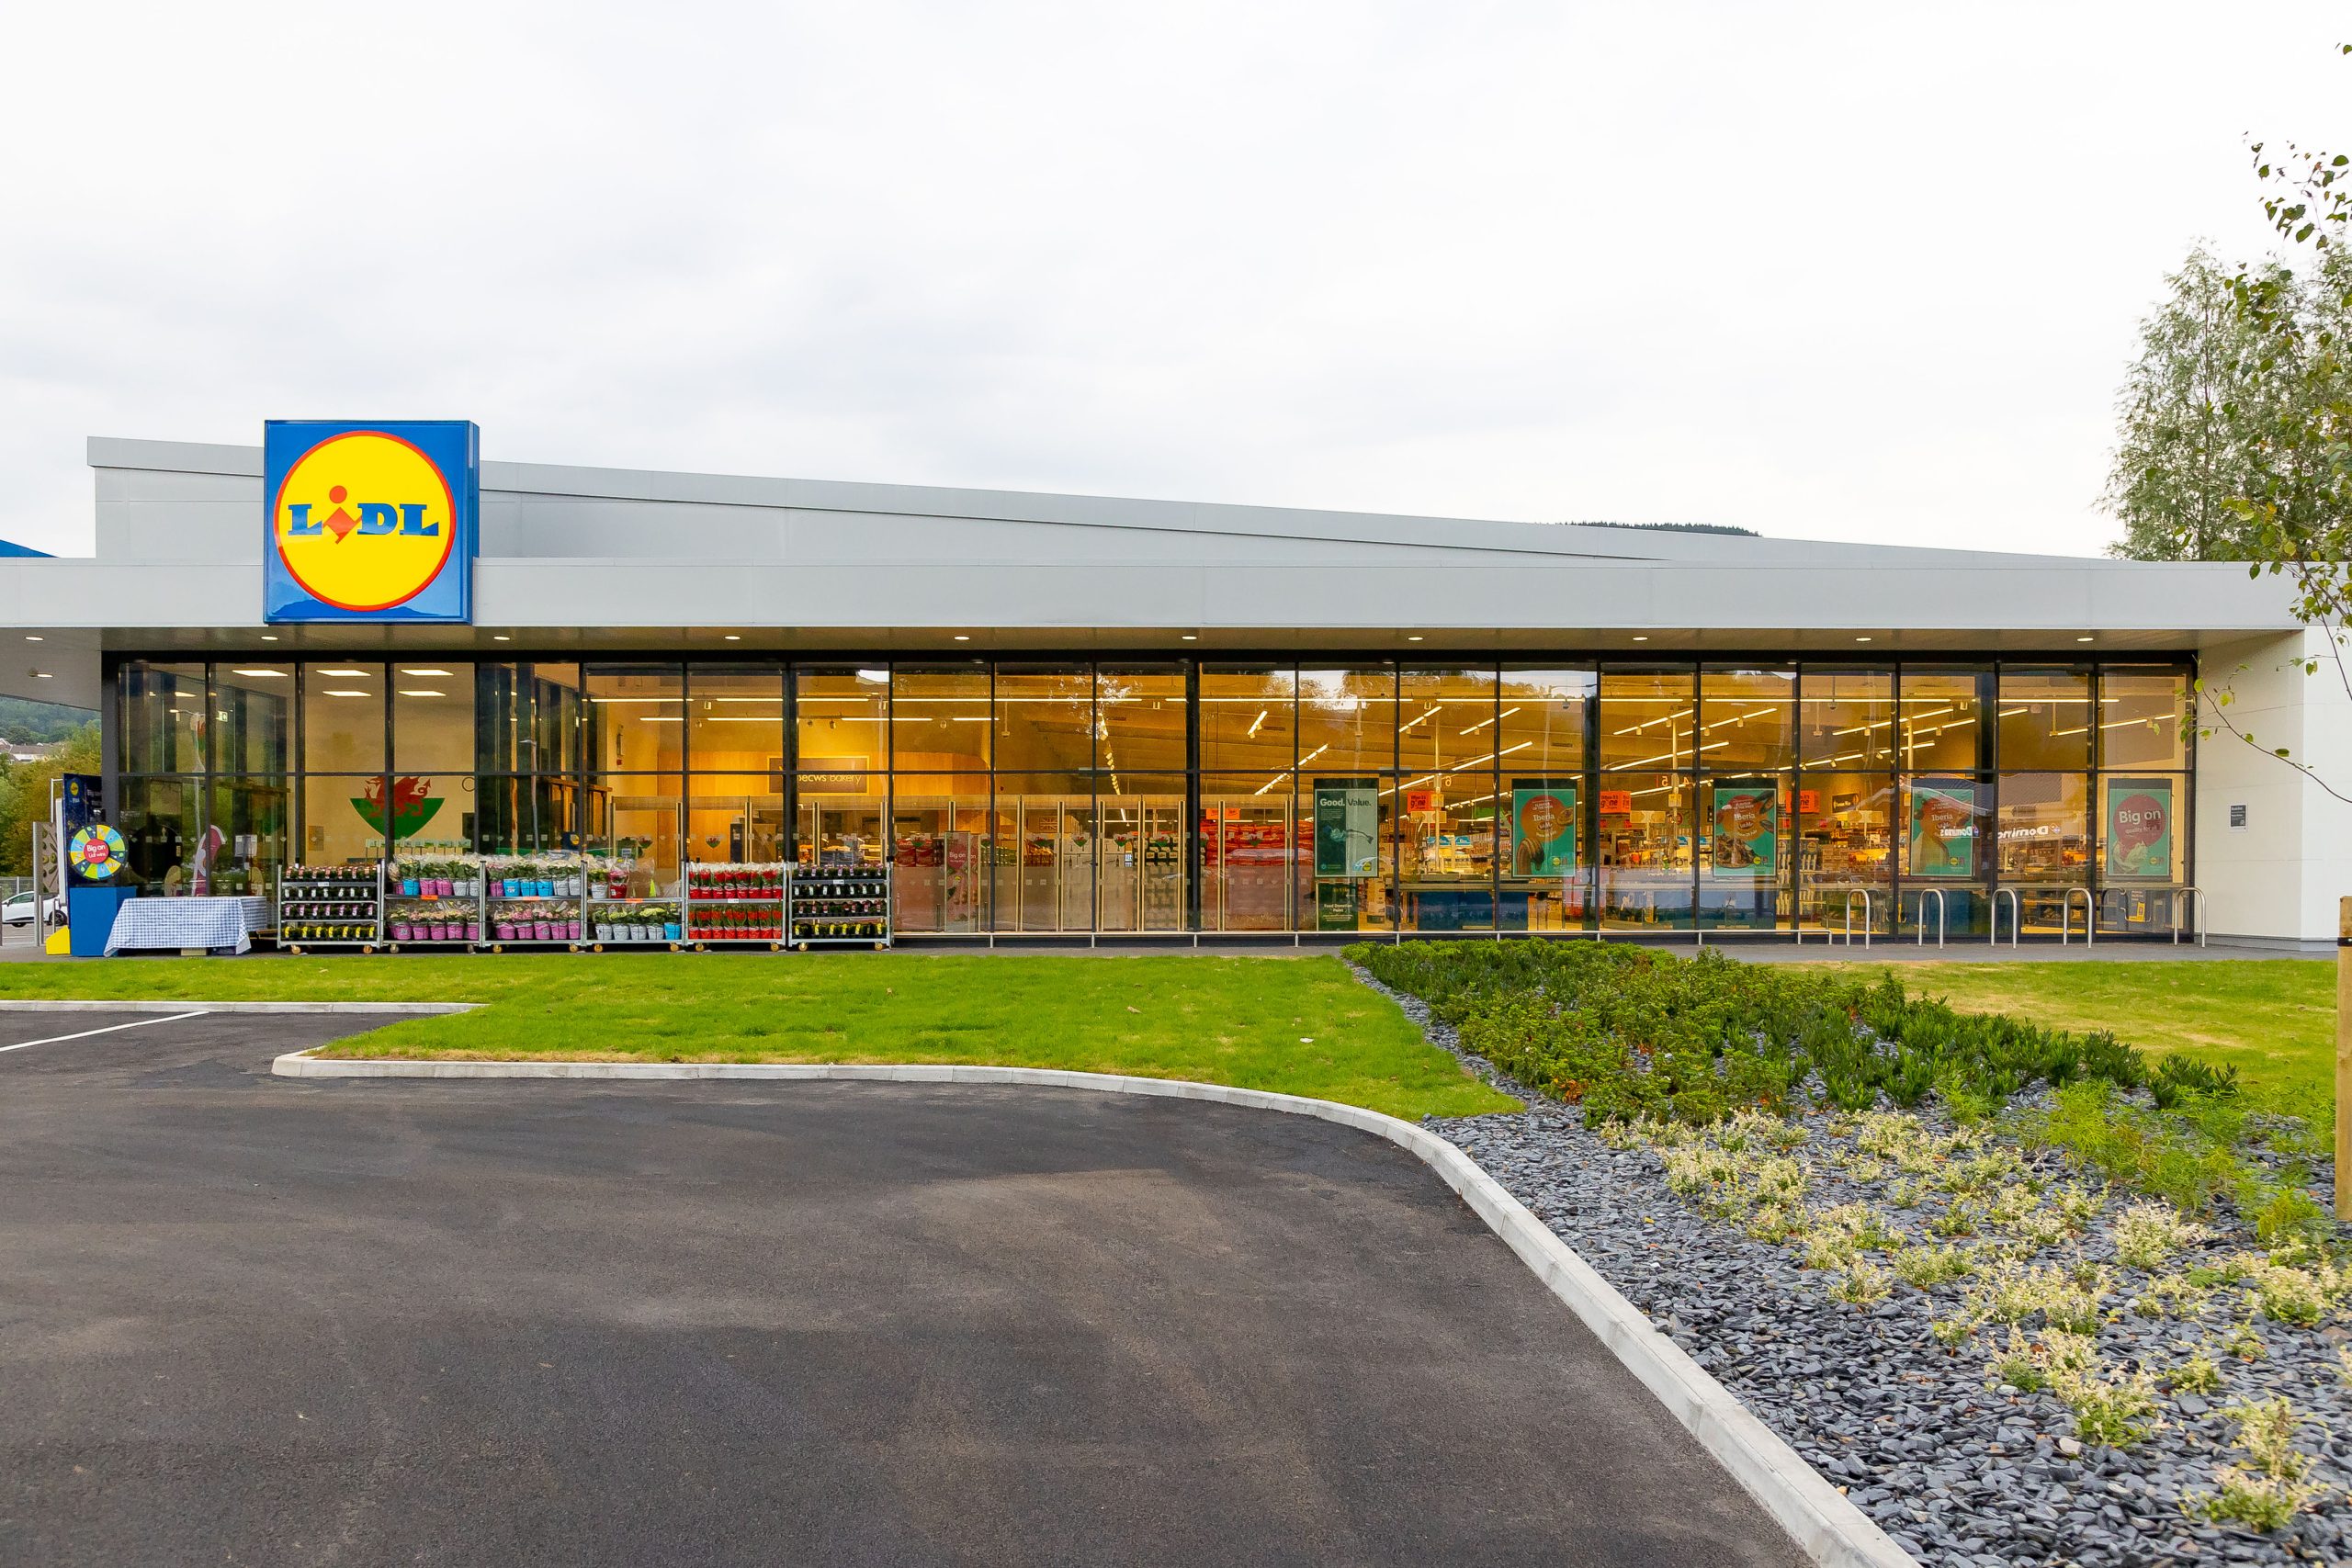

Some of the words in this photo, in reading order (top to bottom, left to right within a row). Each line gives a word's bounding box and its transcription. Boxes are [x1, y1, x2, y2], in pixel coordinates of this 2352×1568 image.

[798, 774, 827, 783] ecws
[1319, 797, 1346, 807] Good.
[1347, 797, 1372, 807] Value.
[1532, 813, 1555, 821] Iberia
[1734, 812, 1756, 821] Iberia
[1931, 812, 1953, 821] Iberia
[2119, 809, 2141, 825] Big
[2144, 810, 2161, 820] on
[86, 844, 97, 853] Big
